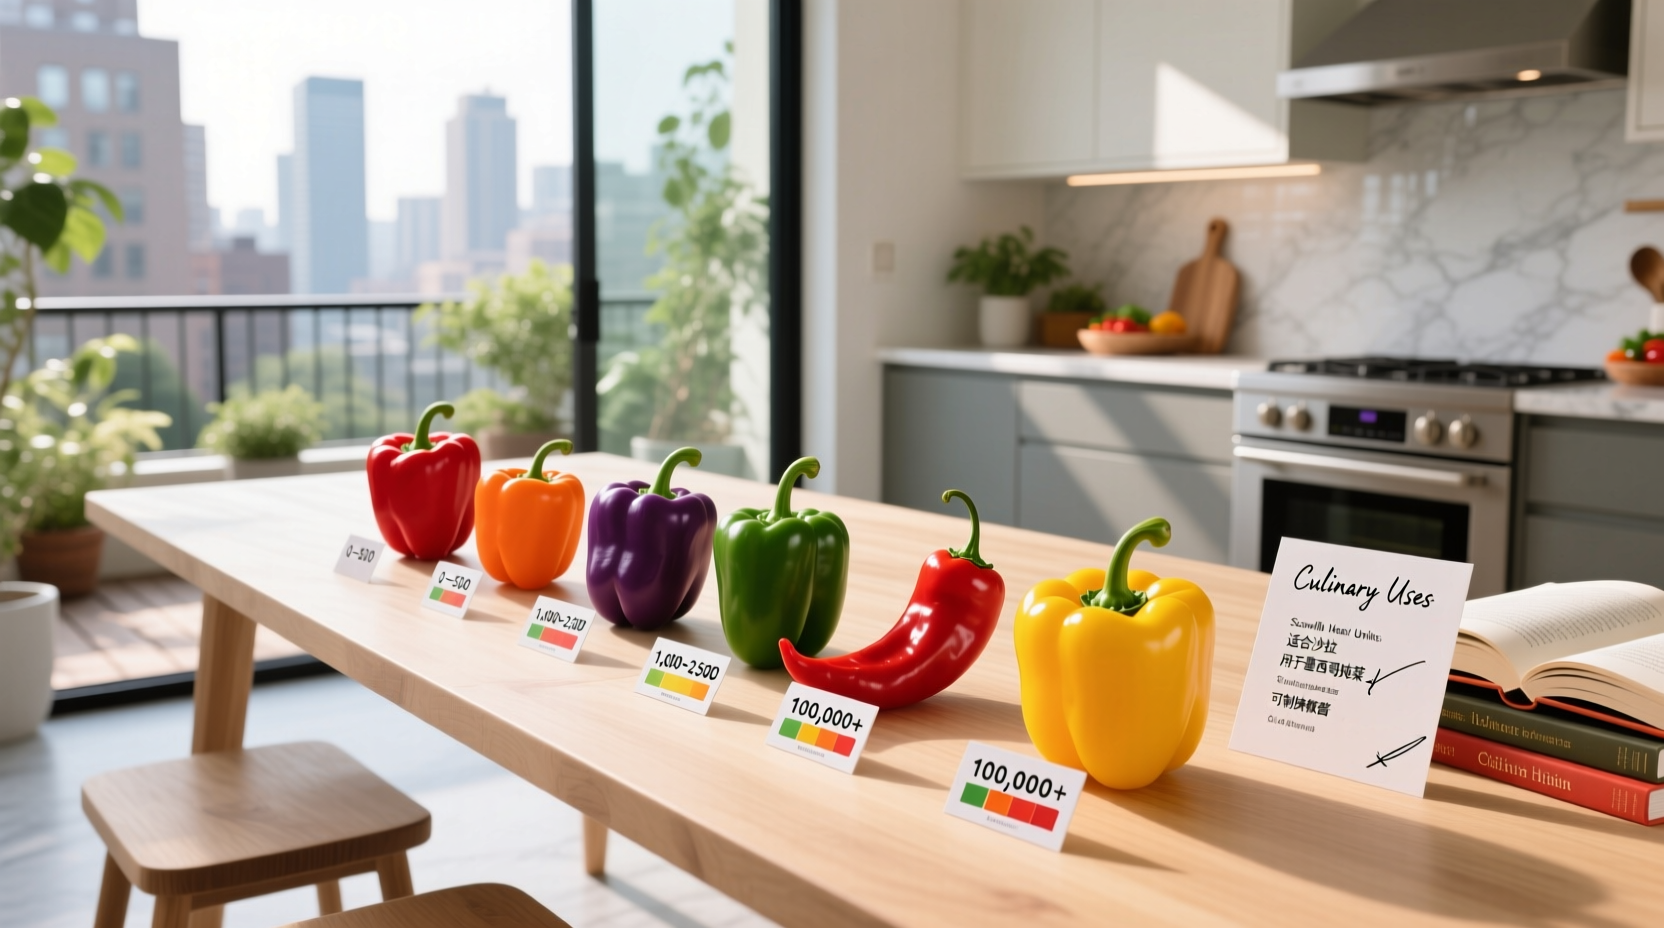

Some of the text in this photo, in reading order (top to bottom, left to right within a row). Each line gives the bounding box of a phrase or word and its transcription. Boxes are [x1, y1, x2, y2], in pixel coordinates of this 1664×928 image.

[1293, 564, 1380, 612] Culinary
[790, 696, 864, 733] 100,000+
[973, 757, 1068, 802] 100,000+
